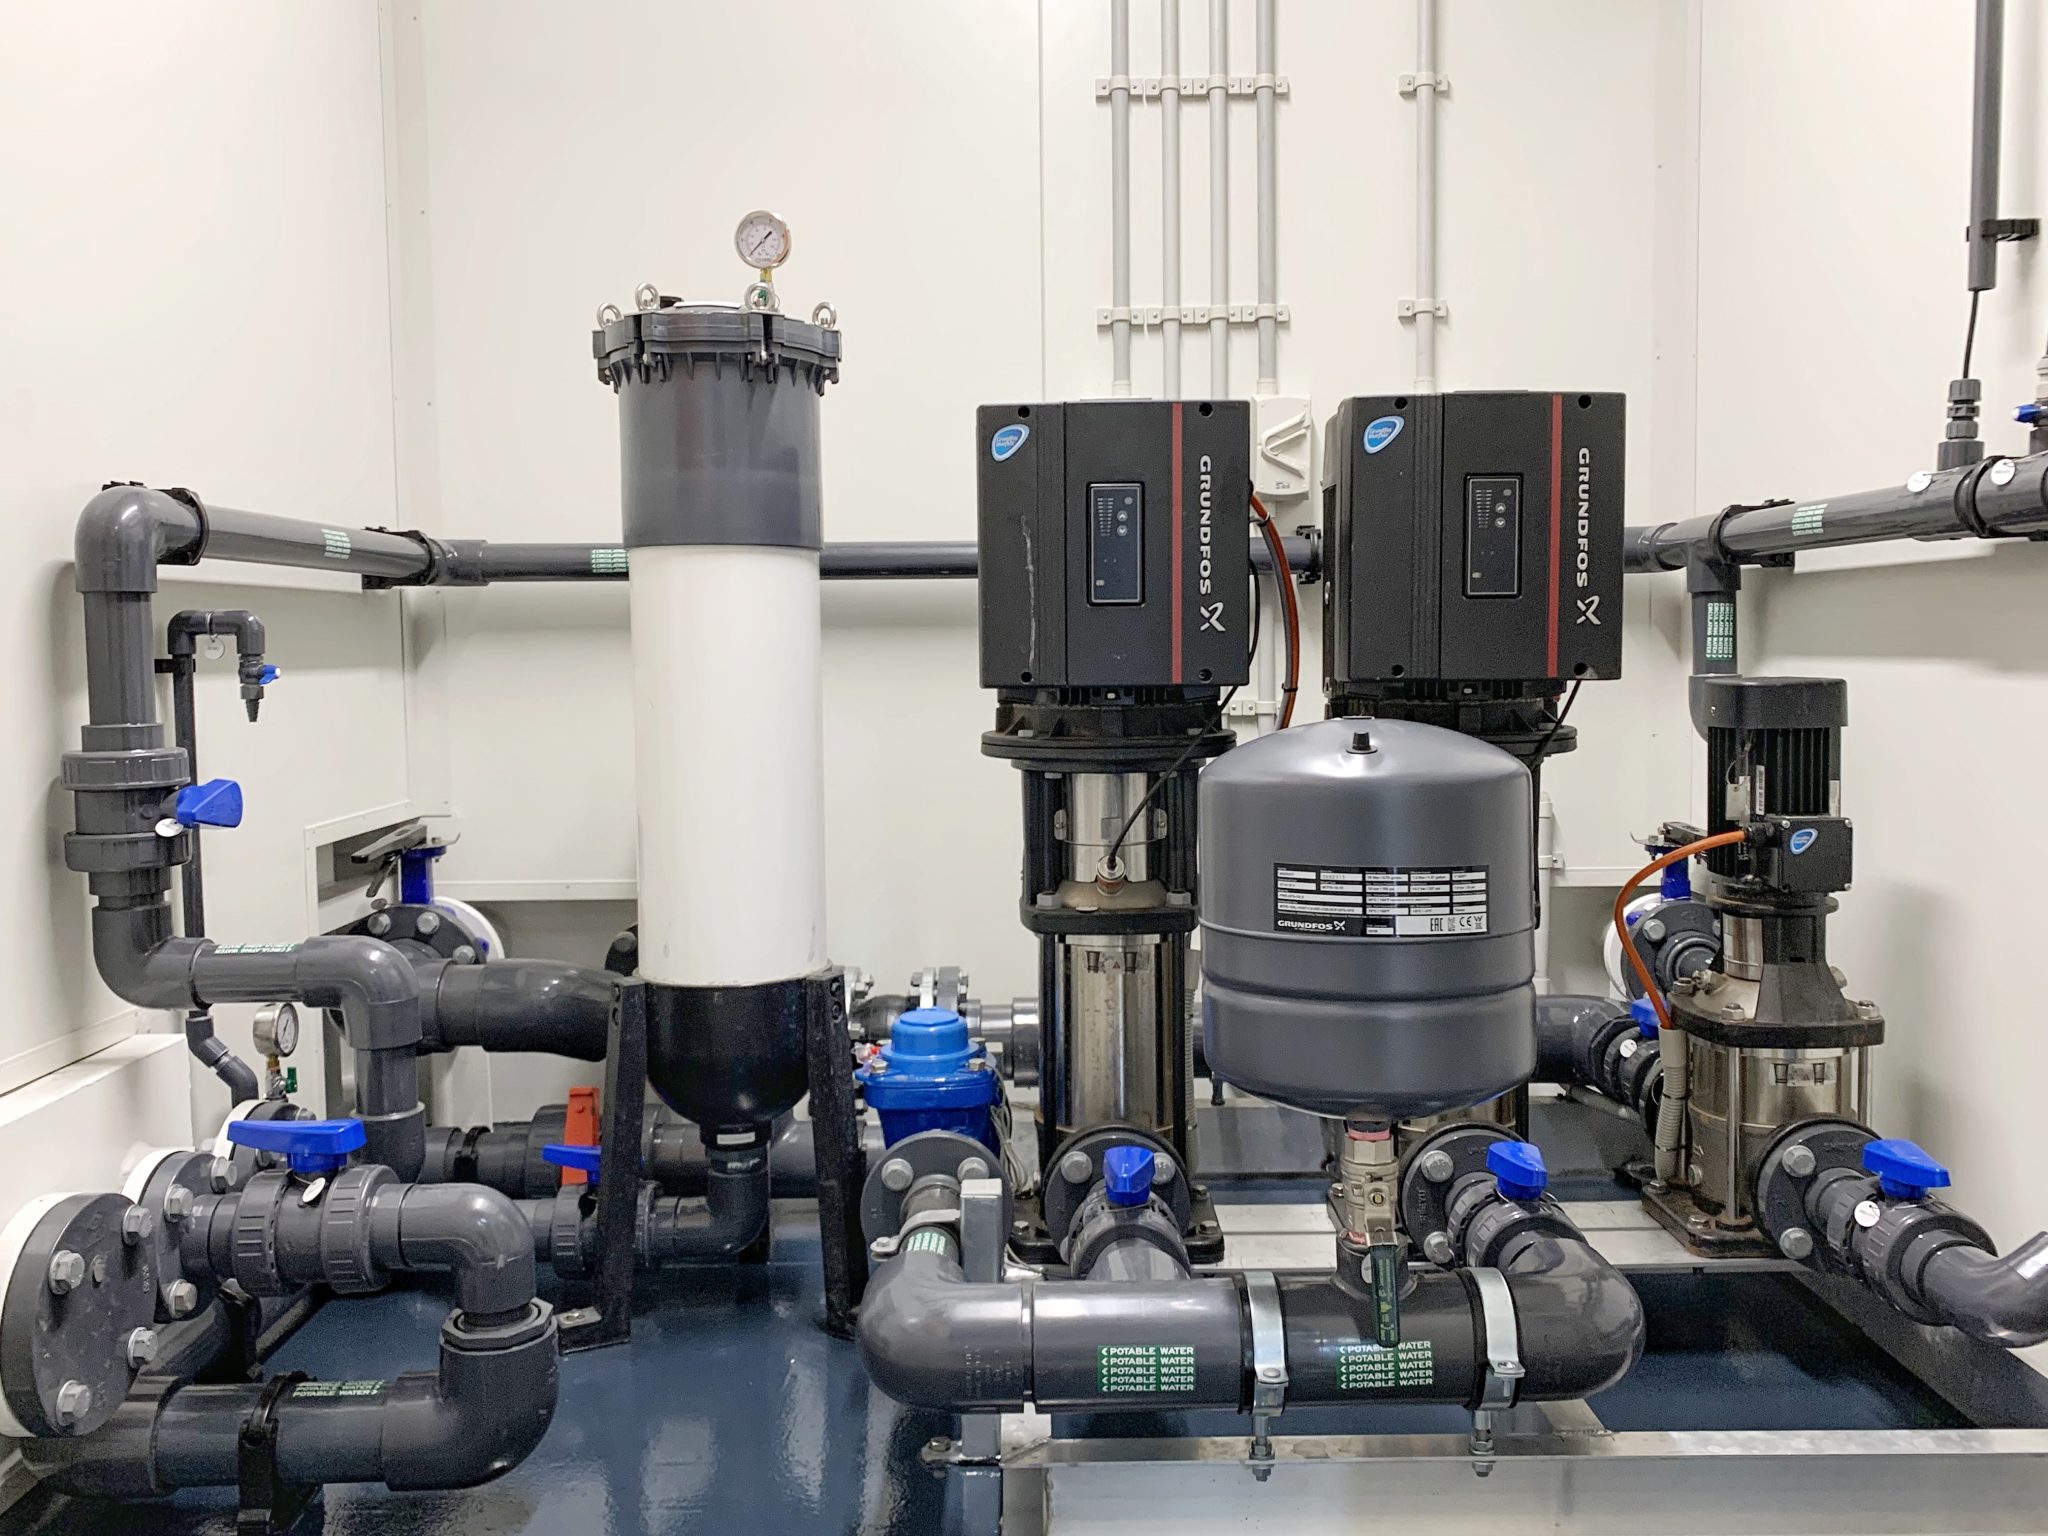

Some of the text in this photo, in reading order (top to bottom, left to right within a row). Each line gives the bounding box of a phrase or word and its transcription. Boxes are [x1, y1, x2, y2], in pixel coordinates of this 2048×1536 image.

[1577, 448, 1590, 588] GRUNDFOS
[1200, 455, 1211, 595] GRUNDFOS
[1277, 920, 1333, 930] GRUNDFOS
[1459, 916, 1472, 927] CE
[1110, 1347, 1194, 1355] POTABLE WATER
[1348, 1341, 1431, 1353] POTAB WATER
[1110, 1357, 1194, 1365] POTABLE WATER
[1348, 1351, 1432, 1363] POTABLE WATER
[1349, 1361, 1433, 1372] POTABLE WATER
[1349, 1370, 1433, 1381] POTABLE WATER
[1110, 1384, 1194, 1392] POTABLE WATER
[1349, 1378, 1433, 1389] POTABLE WATER
